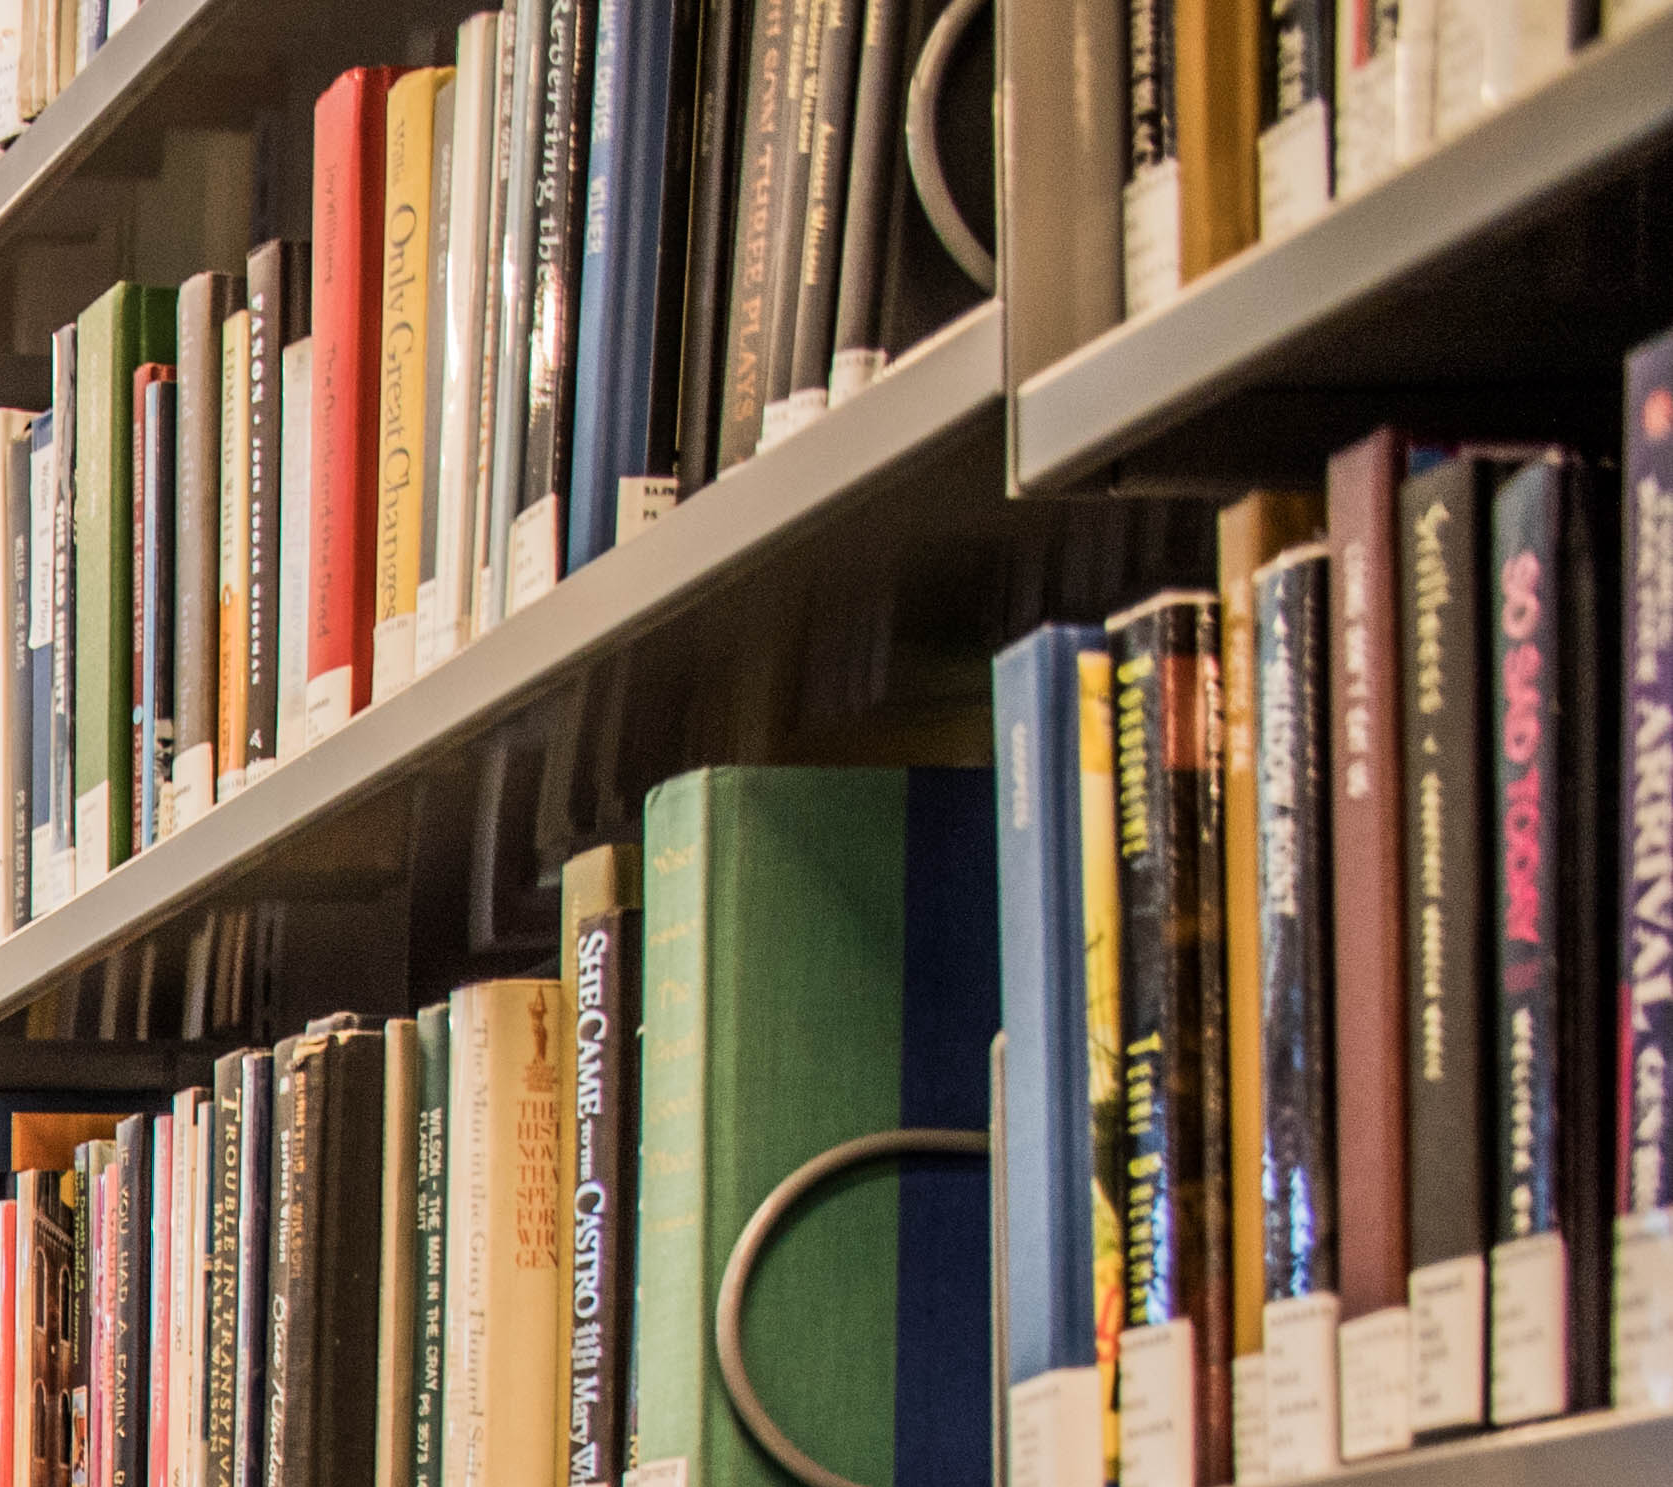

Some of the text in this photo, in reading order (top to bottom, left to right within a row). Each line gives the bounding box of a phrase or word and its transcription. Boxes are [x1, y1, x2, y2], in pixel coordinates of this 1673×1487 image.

[379, 203, 417, 622] Only Great Changes
[251, 294, 264, 687] FANON JOHN EDGAR WIDEMAN
[1504, 551, 1540, 944] SO SAD TODAY
[576, 931, 607, 1009] SHE
[576, 1009, 607, 1118] CAME
[219, 1088, 241, 1254] TROUBLE
[274, 1130, 291, 1200] Barbara
[415, 1111, 427, 1230] FLANNEL SUIT
[428, 1107, 442, 1176] WILSON
[273, 1204, 290, 1263] Wilson
[427, 1198, 441, 1229] THE
[218, 1261, 238, 1298] IN
[426, 1233, 440, 1275] MAN
[573, 1182, 603, 1318] CASTRO
[425, 1309, 439, 1339] THE
[426, 1282, 440, 1301] IN
[270, 1294, 289, 1361] Blue
[424, 1346, 439, 1391] GRAY
[416, 1393, 429, 1414] PS
[571, 1377, 599, 1446] Mary
[415, 1422, 428, 1465] 3573
